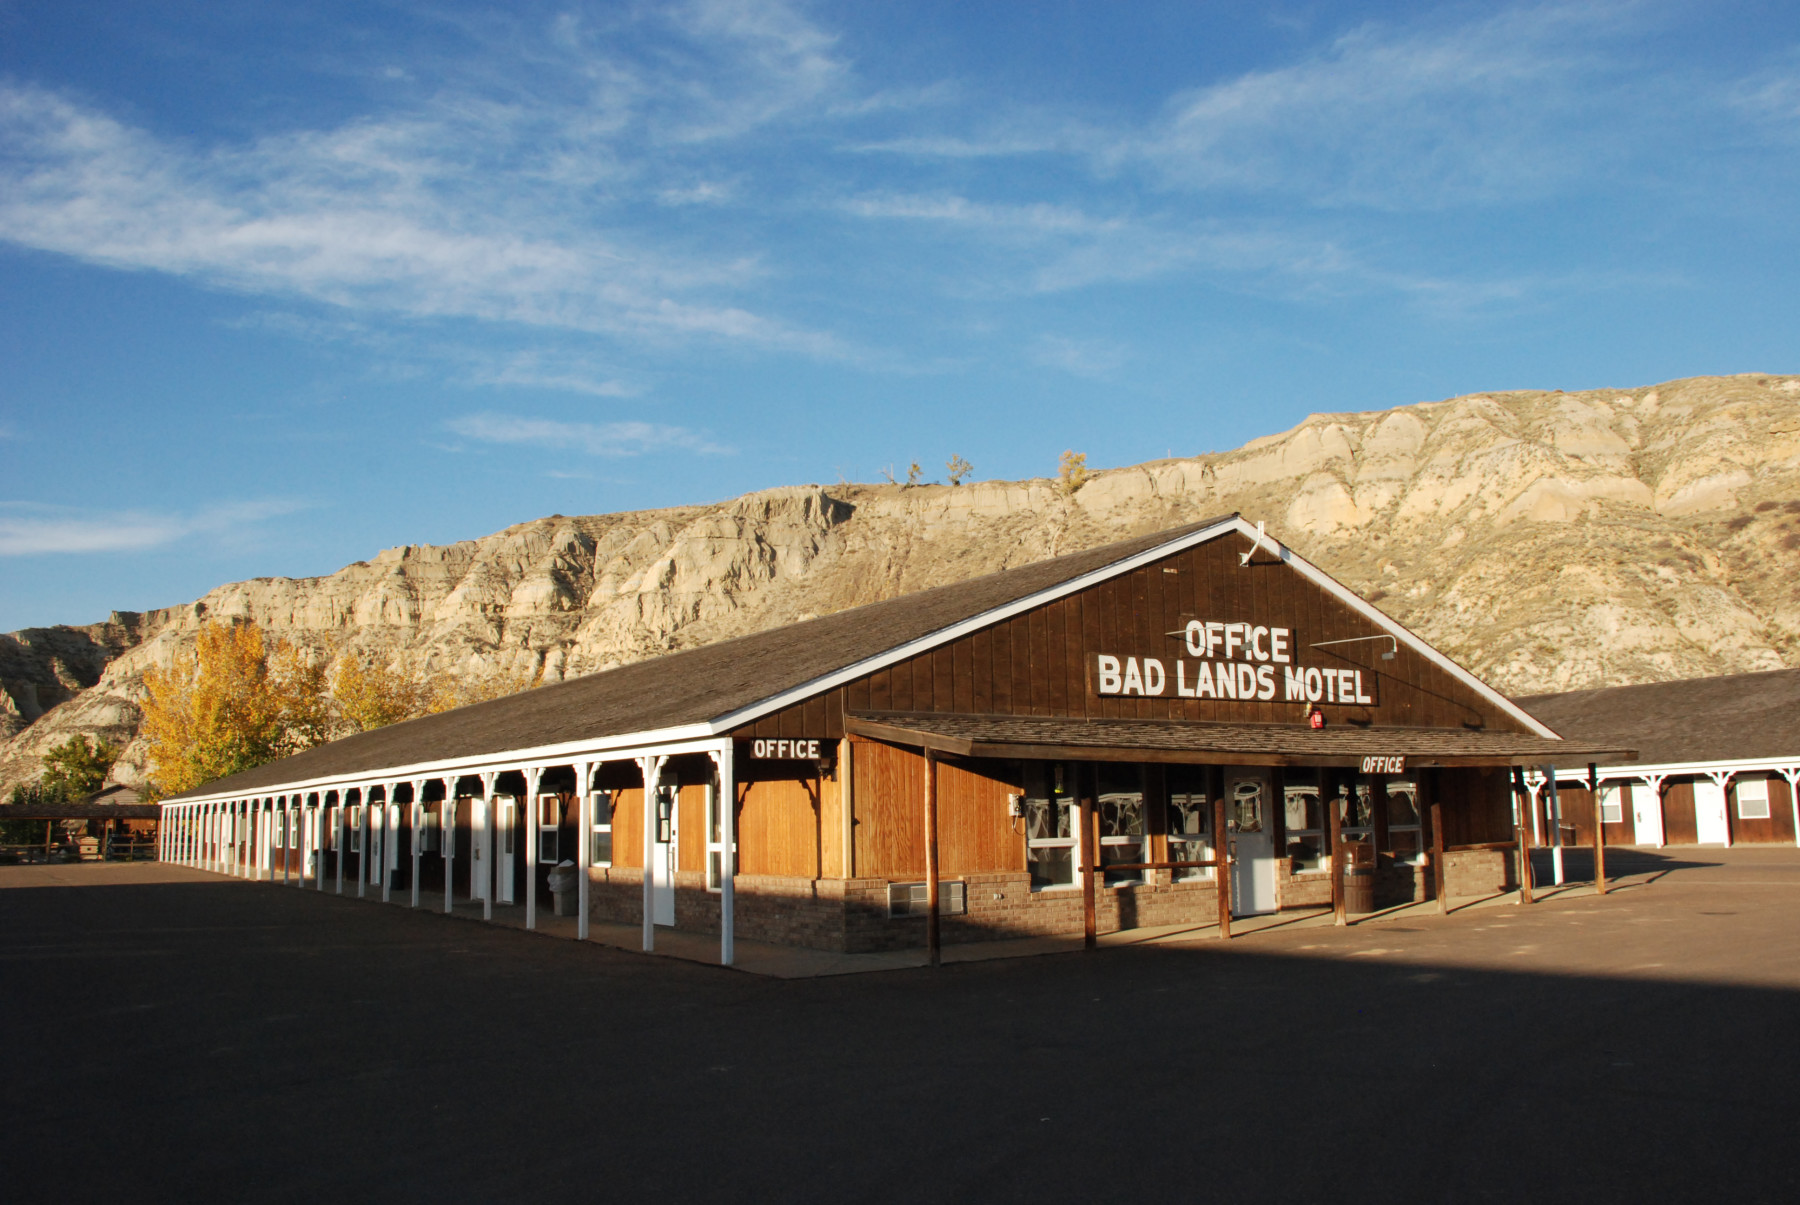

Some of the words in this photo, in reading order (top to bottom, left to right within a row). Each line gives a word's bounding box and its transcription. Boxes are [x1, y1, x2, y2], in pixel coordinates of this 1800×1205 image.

[1185, 620, 1290, 663] OFFICE
[1098, 655, 1165, 696] BAD
[1177, 660, 1276, 700] LANDS
[1285, 666, 1371, 704] MOTEL
[754, 739, 819, 758] OFFICE
[1362, 756, 1404, 773] OFFICE
